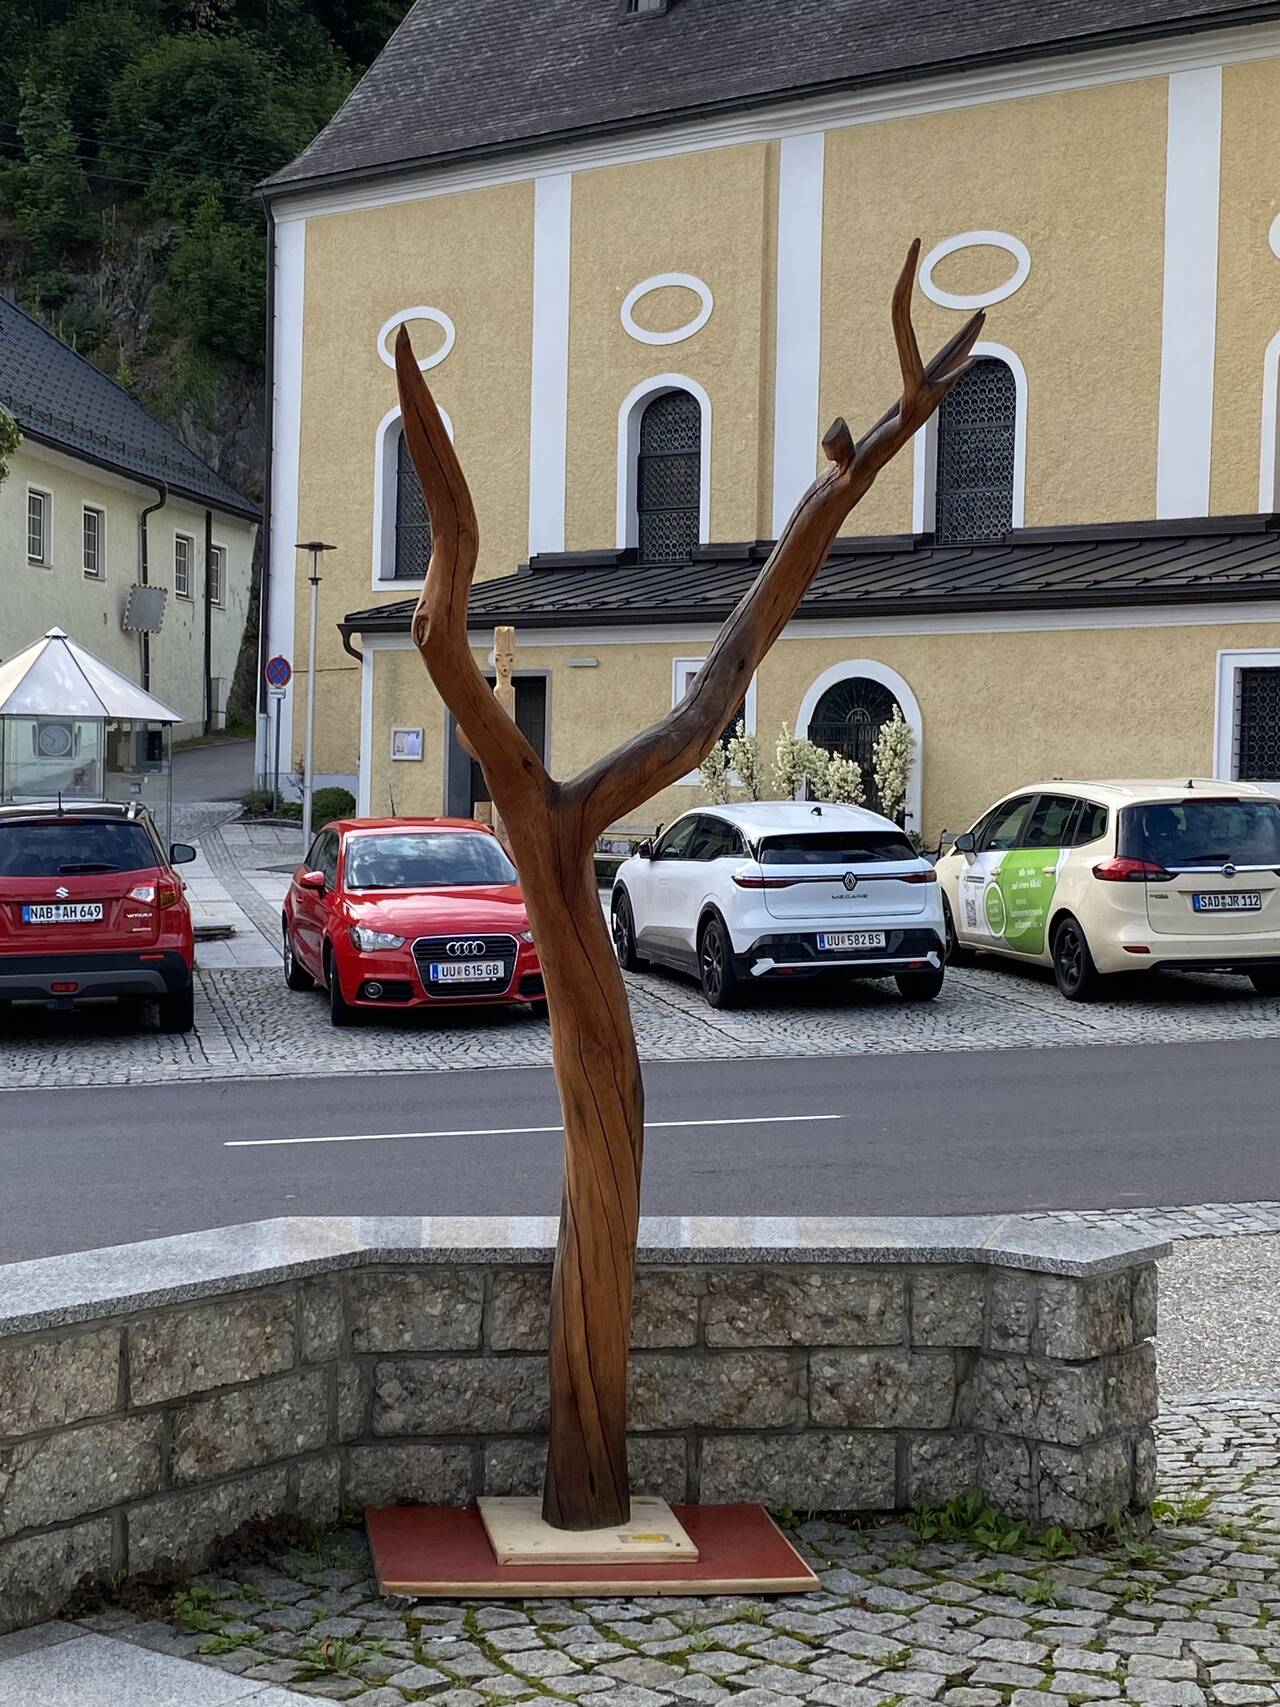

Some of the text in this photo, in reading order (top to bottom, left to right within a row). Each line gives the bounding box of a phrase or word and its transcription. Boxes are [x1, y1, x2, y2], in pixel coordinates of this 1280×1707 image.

[1201, 894, 1260, 908] SAD JR 112
[30, 905, 101, 919] NAB AH 649
[827, 933, 881, 947] UU 582 BS
[442, 964, 499, 977] UU 615 GB
